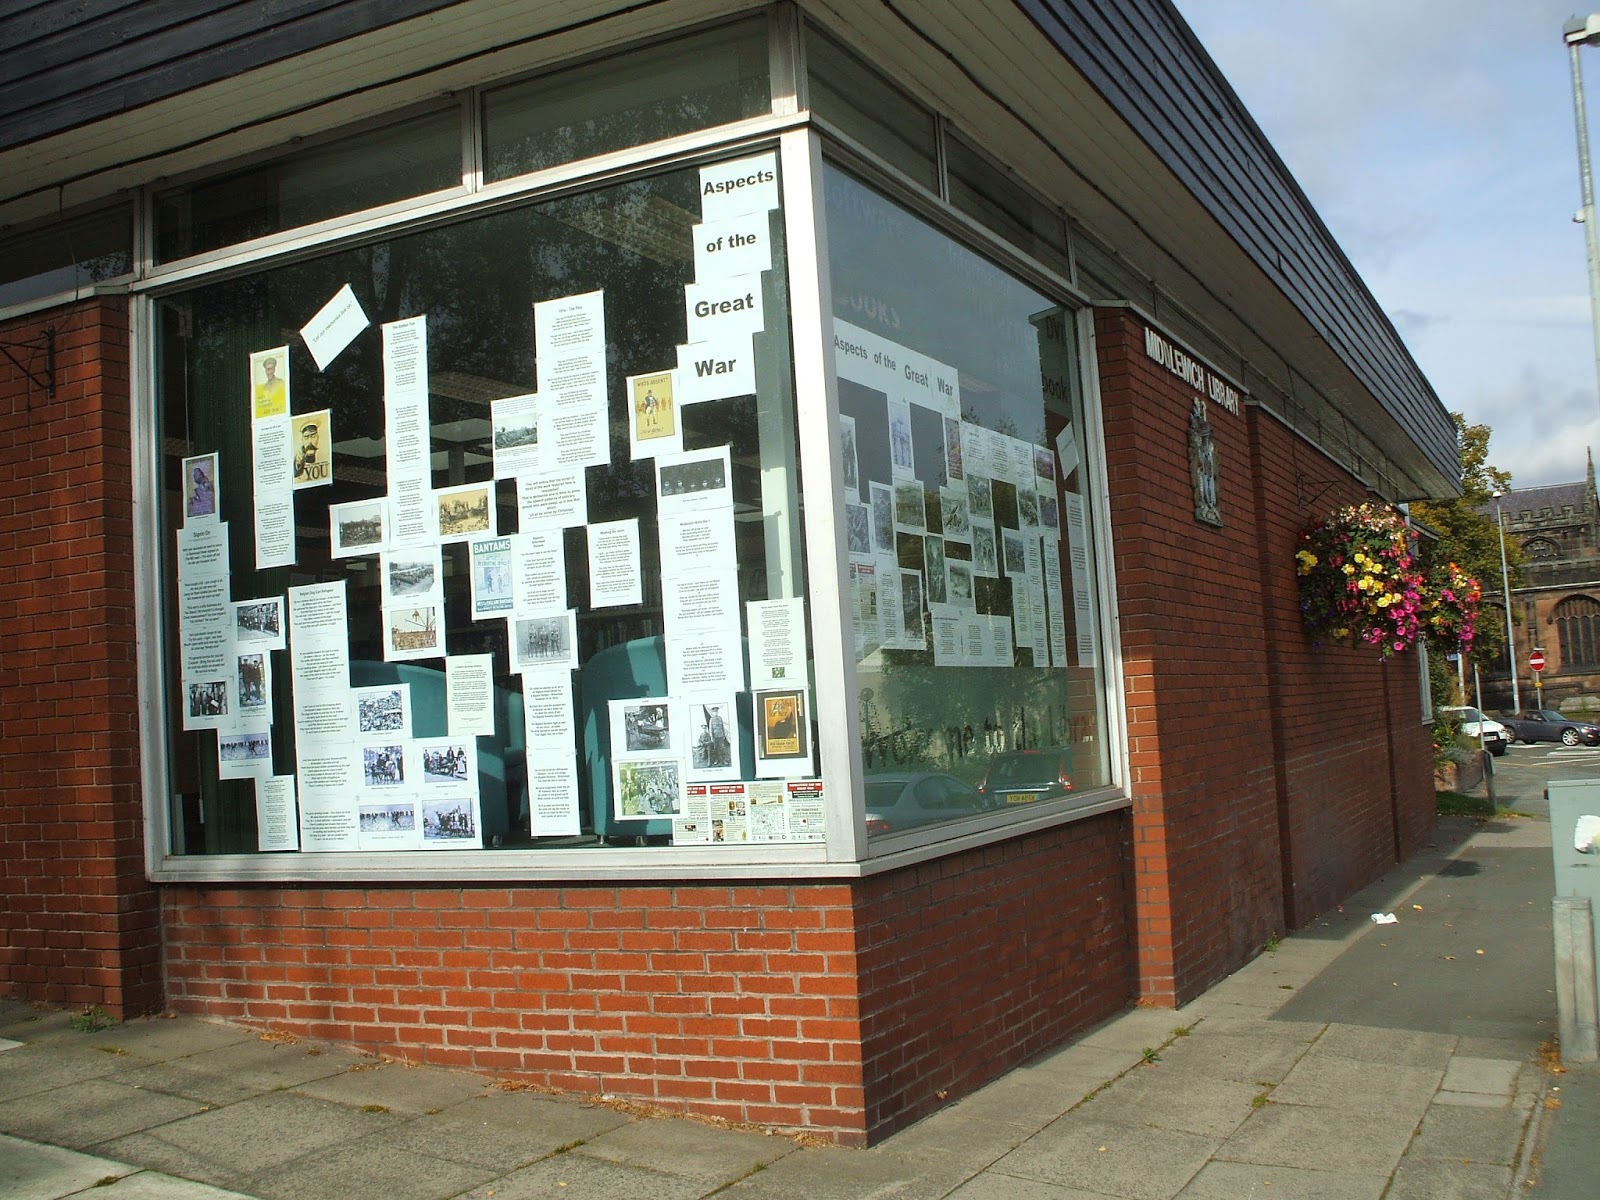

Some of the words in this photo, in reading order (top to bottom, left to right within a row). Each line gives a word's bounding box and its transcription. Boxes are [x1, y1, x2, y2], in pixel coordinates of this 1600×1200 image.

[704, 169, 774, 196] Aspects
[706, 238, 722, 253] of
[728, 232, 757, 249] the
[695, 293, 754, 318] Great
[695, 358, 736, 378] War
[834, 334, 868, 360] Aspects
[874, 350, 882, 365] of
[883, 352, 897, 370] the
[904, 364, 929, 388] Great
[936, 376, 954, 397] War
[1144, 326, 1205, 393] MIDDLEWICH
[1207, 372, 1239, 417] LIBRARY
[304, 463, 330, 481] YOU
[474, 540, 511, 554] BANTAMS
